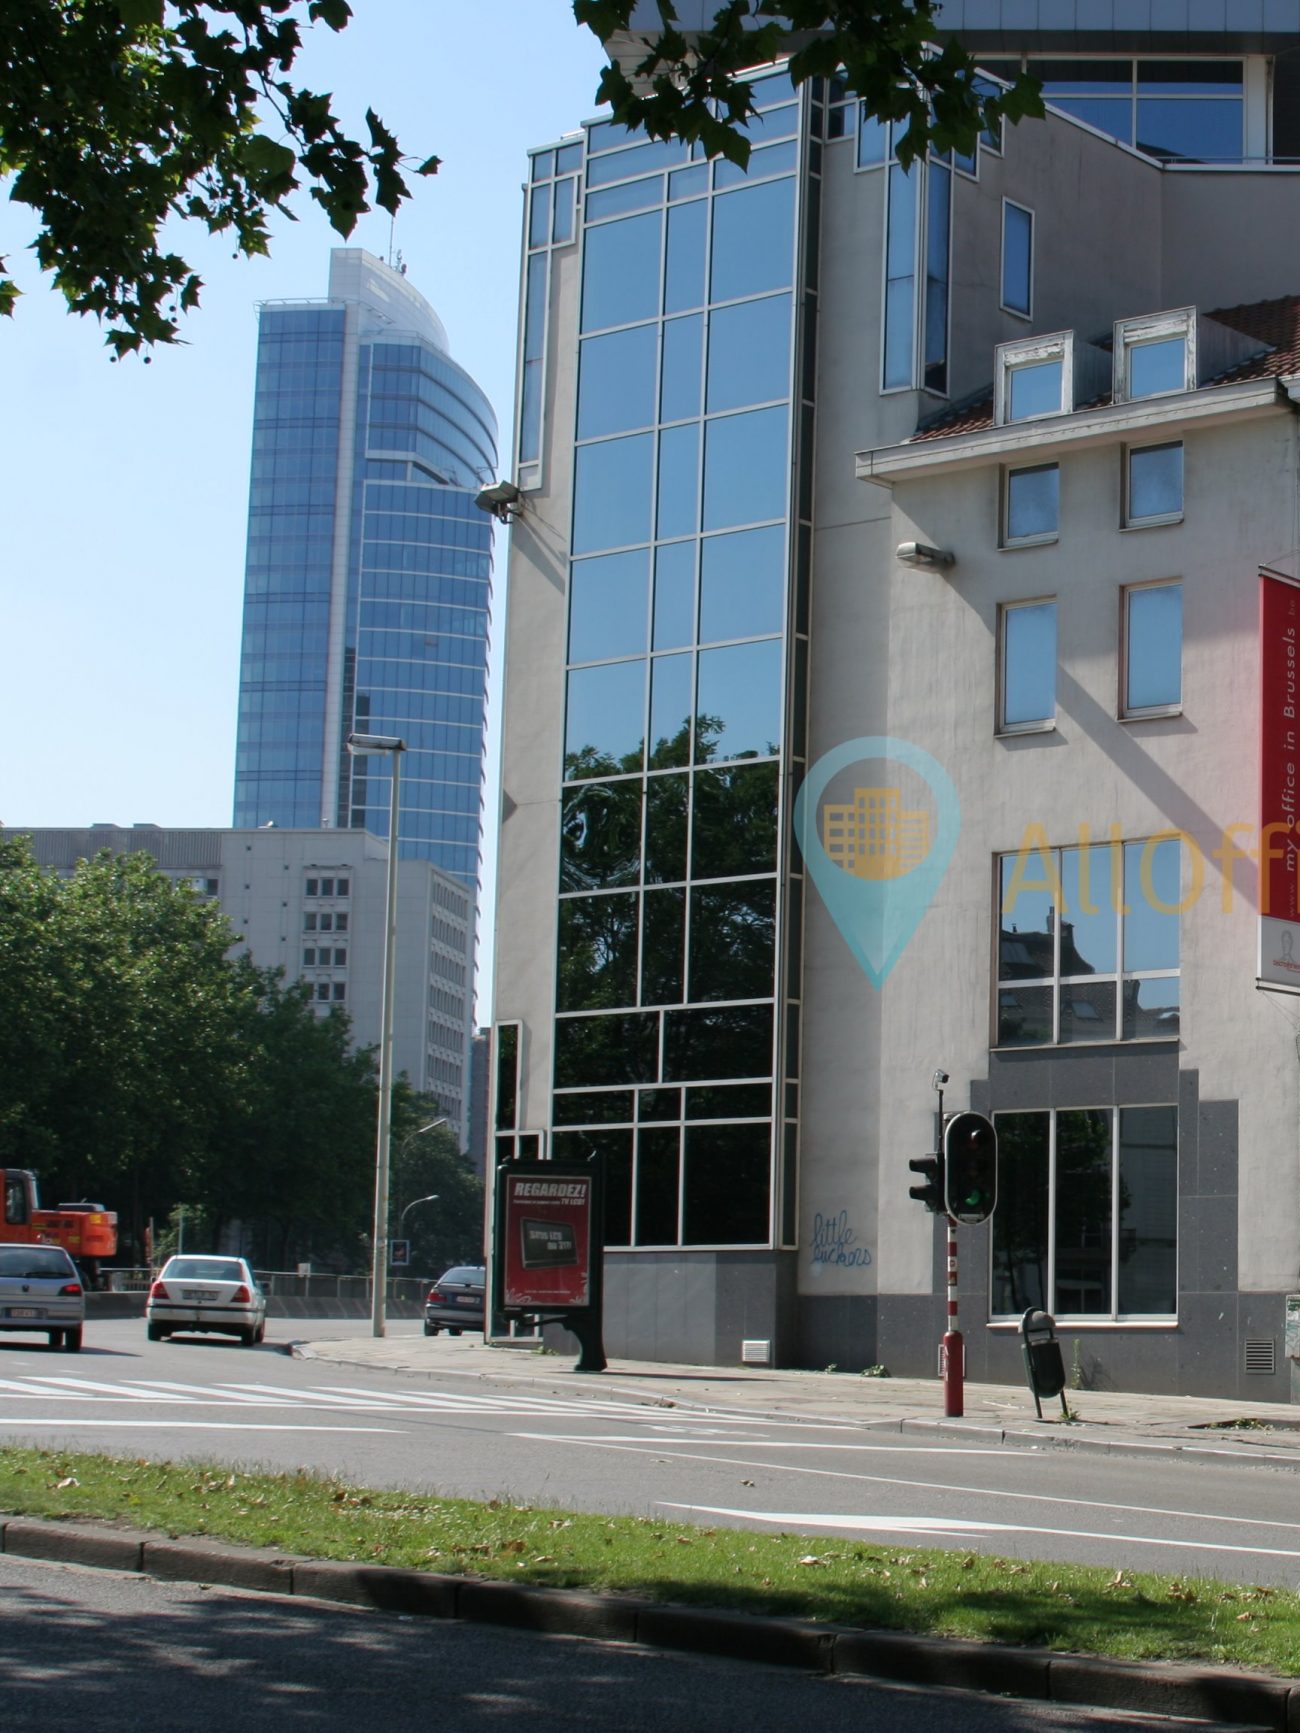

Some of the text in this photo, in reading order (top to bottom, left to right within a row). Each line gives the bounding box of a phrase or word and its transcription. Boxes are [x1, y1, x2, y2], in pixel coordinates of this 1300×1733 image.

[1281, 627, 1296, 719] Brussels
[1283, 730, 1296, 750] in
[1281, 761, 1296, 829] office
[1286, 838, 1298, 872] my
[513, 1182, 587, 1198] REGARDEZ!
[810, 1209, 858, 1247] little
